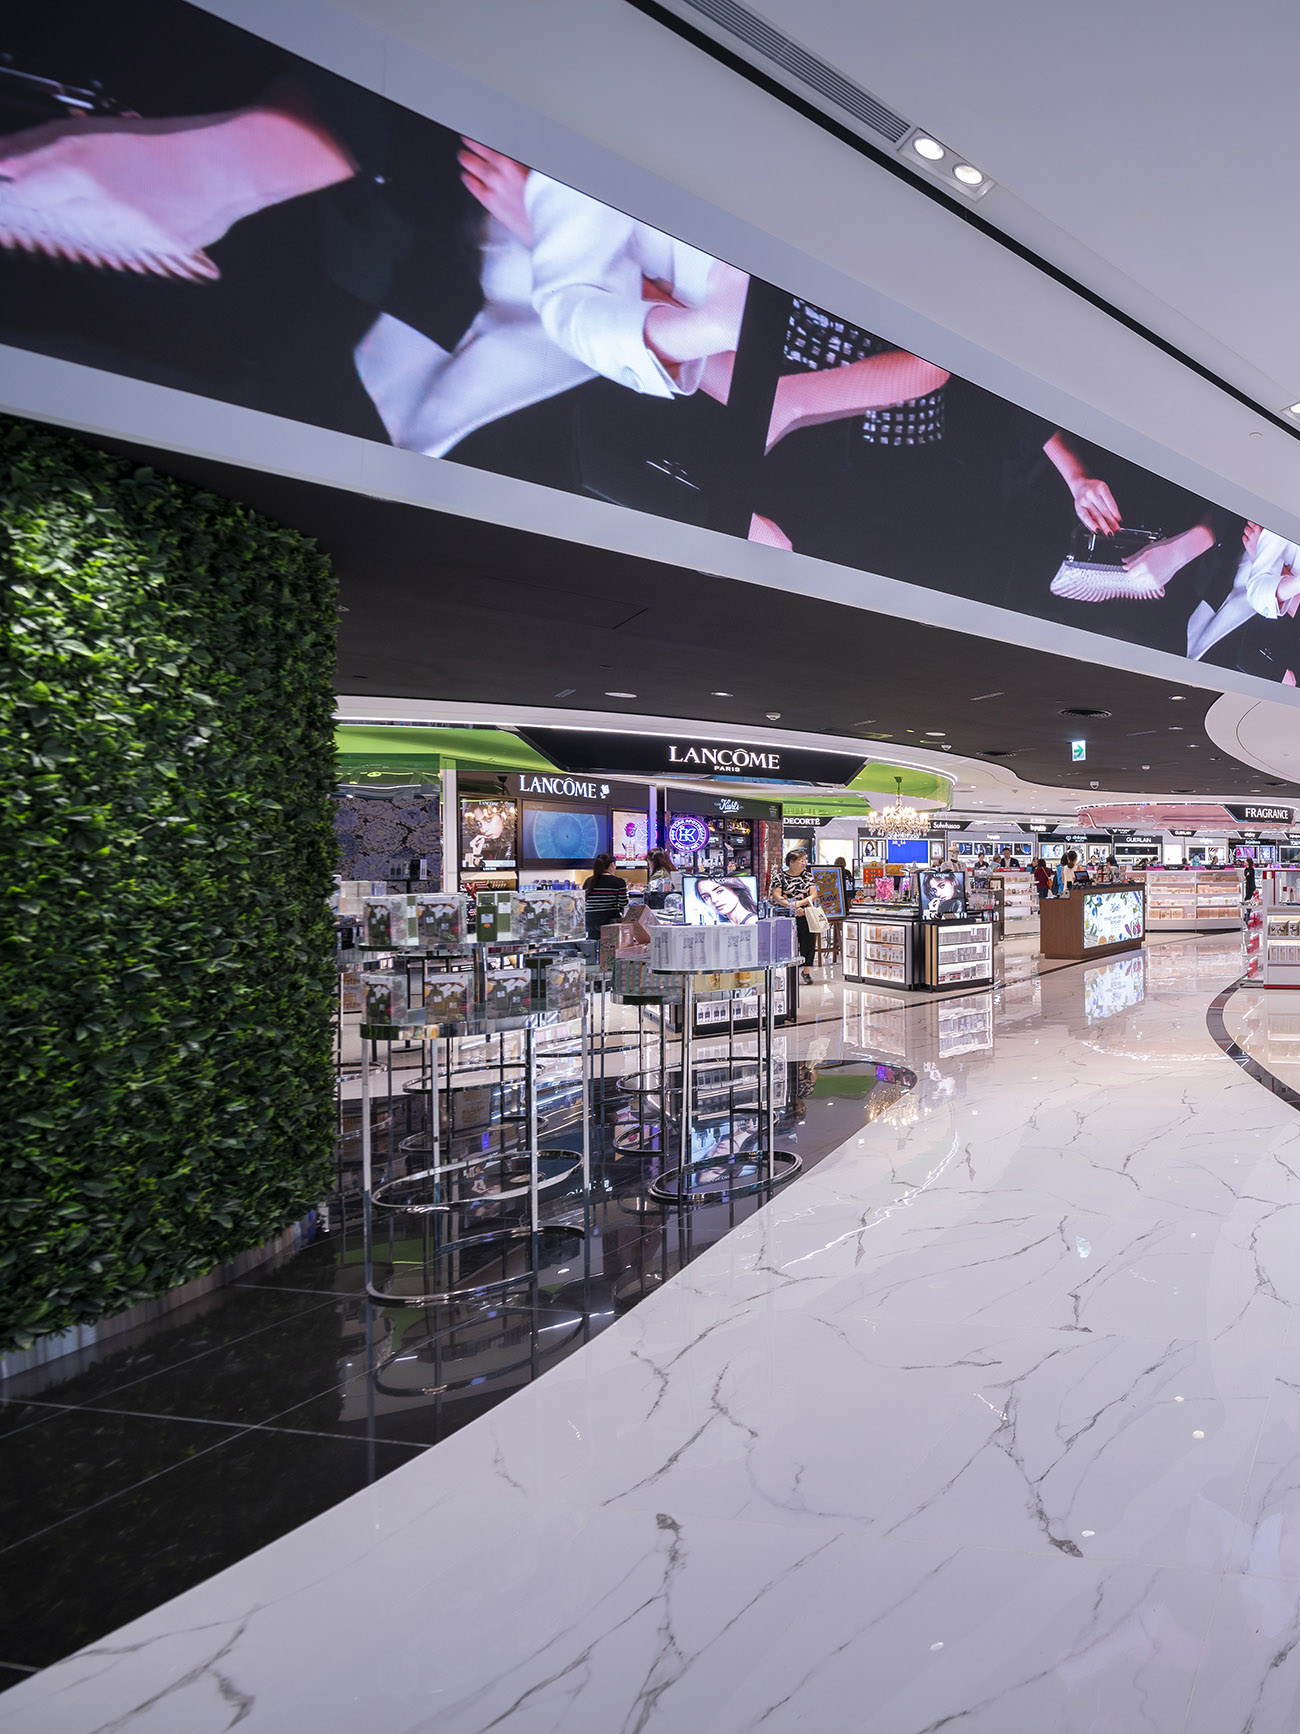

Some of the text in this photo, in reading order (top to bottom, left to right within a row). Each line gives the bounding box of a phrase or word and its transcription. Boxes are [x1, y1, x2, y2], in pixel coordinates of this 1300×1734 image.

[668, 745, 780, 769] LANCÔME
[714, 765, 741, 773] PARIS
[519, 775, 597, 798] LANCÔME
[1245, 807, 1288, 820] FRAGRANCE
